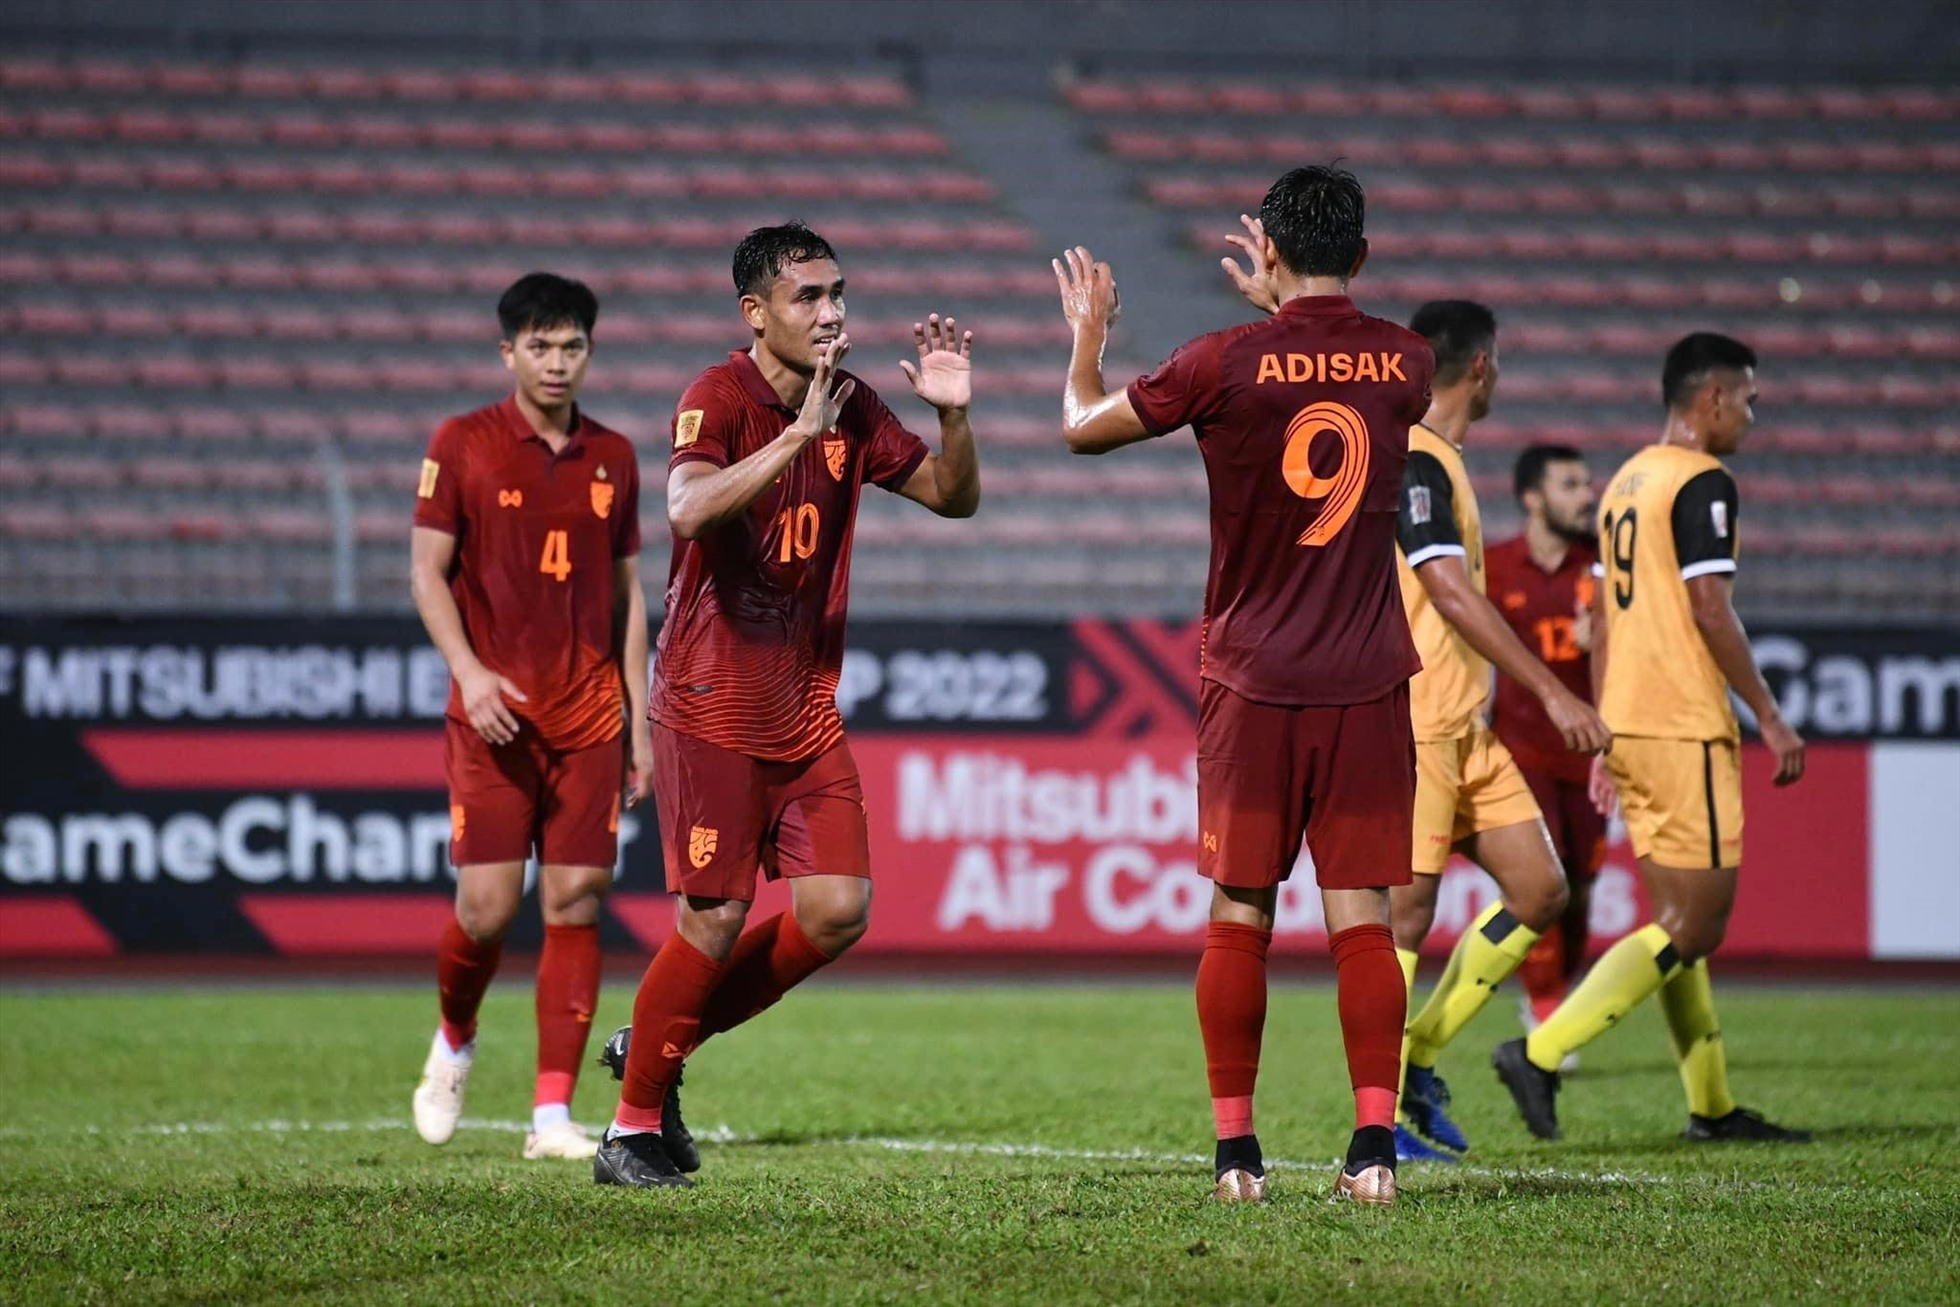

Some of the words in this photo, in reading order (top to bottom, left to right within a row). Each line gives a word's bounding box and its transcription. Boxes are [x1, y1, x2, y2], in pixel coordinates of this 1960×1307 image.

[1256, 352, 1407, 384] ADISAK
[1281, 401, 1370, 546] 9
[540, 530, 571, 582] 4
[778, 502, 820, 563] 10
[1604, 507, 1638, 611] 19
[22, 645, 400, 719] MITSUBISHI
[886, 649, 1048, 720] 2022
[938, 847, 1067, 931] Air
